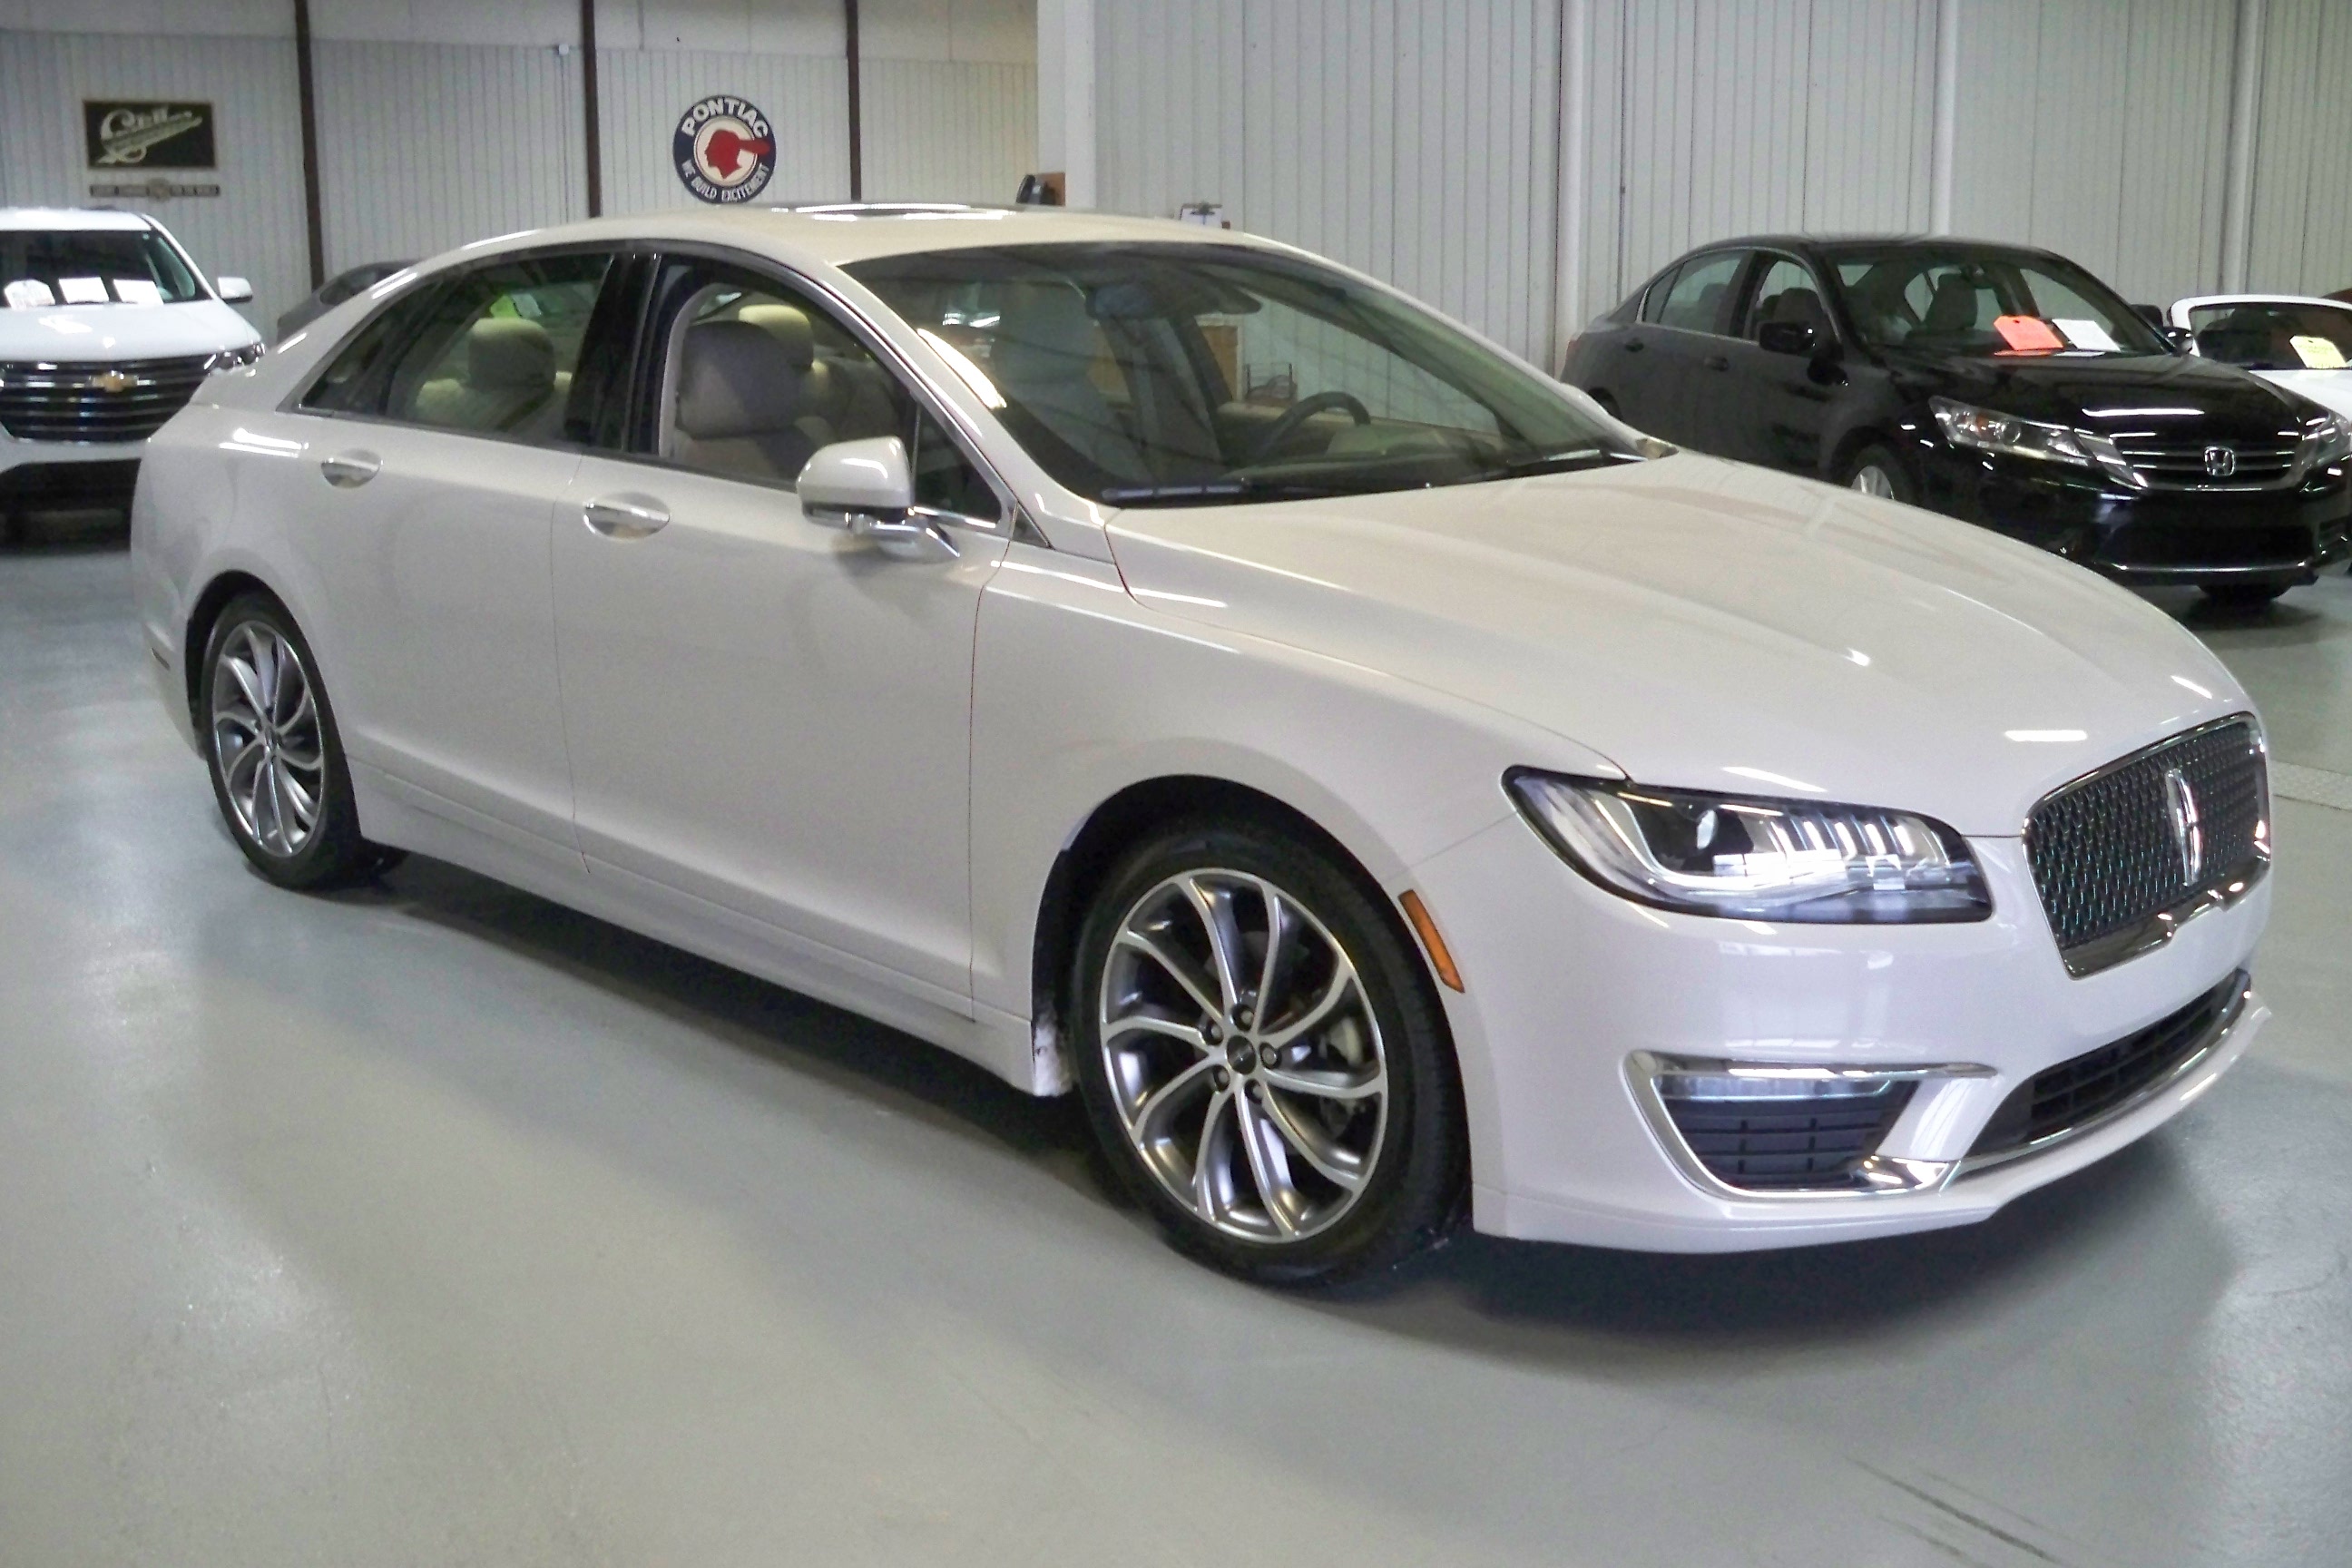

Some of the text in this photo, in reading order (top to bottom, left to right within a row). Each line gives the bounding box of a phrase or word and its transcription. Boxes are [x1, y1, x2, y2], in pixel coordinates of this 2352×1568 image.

[681, 97, 769, 138] PONTIAC
[681, 159, 696, 178] WE
[691, 175, 718, 200] BUILD
